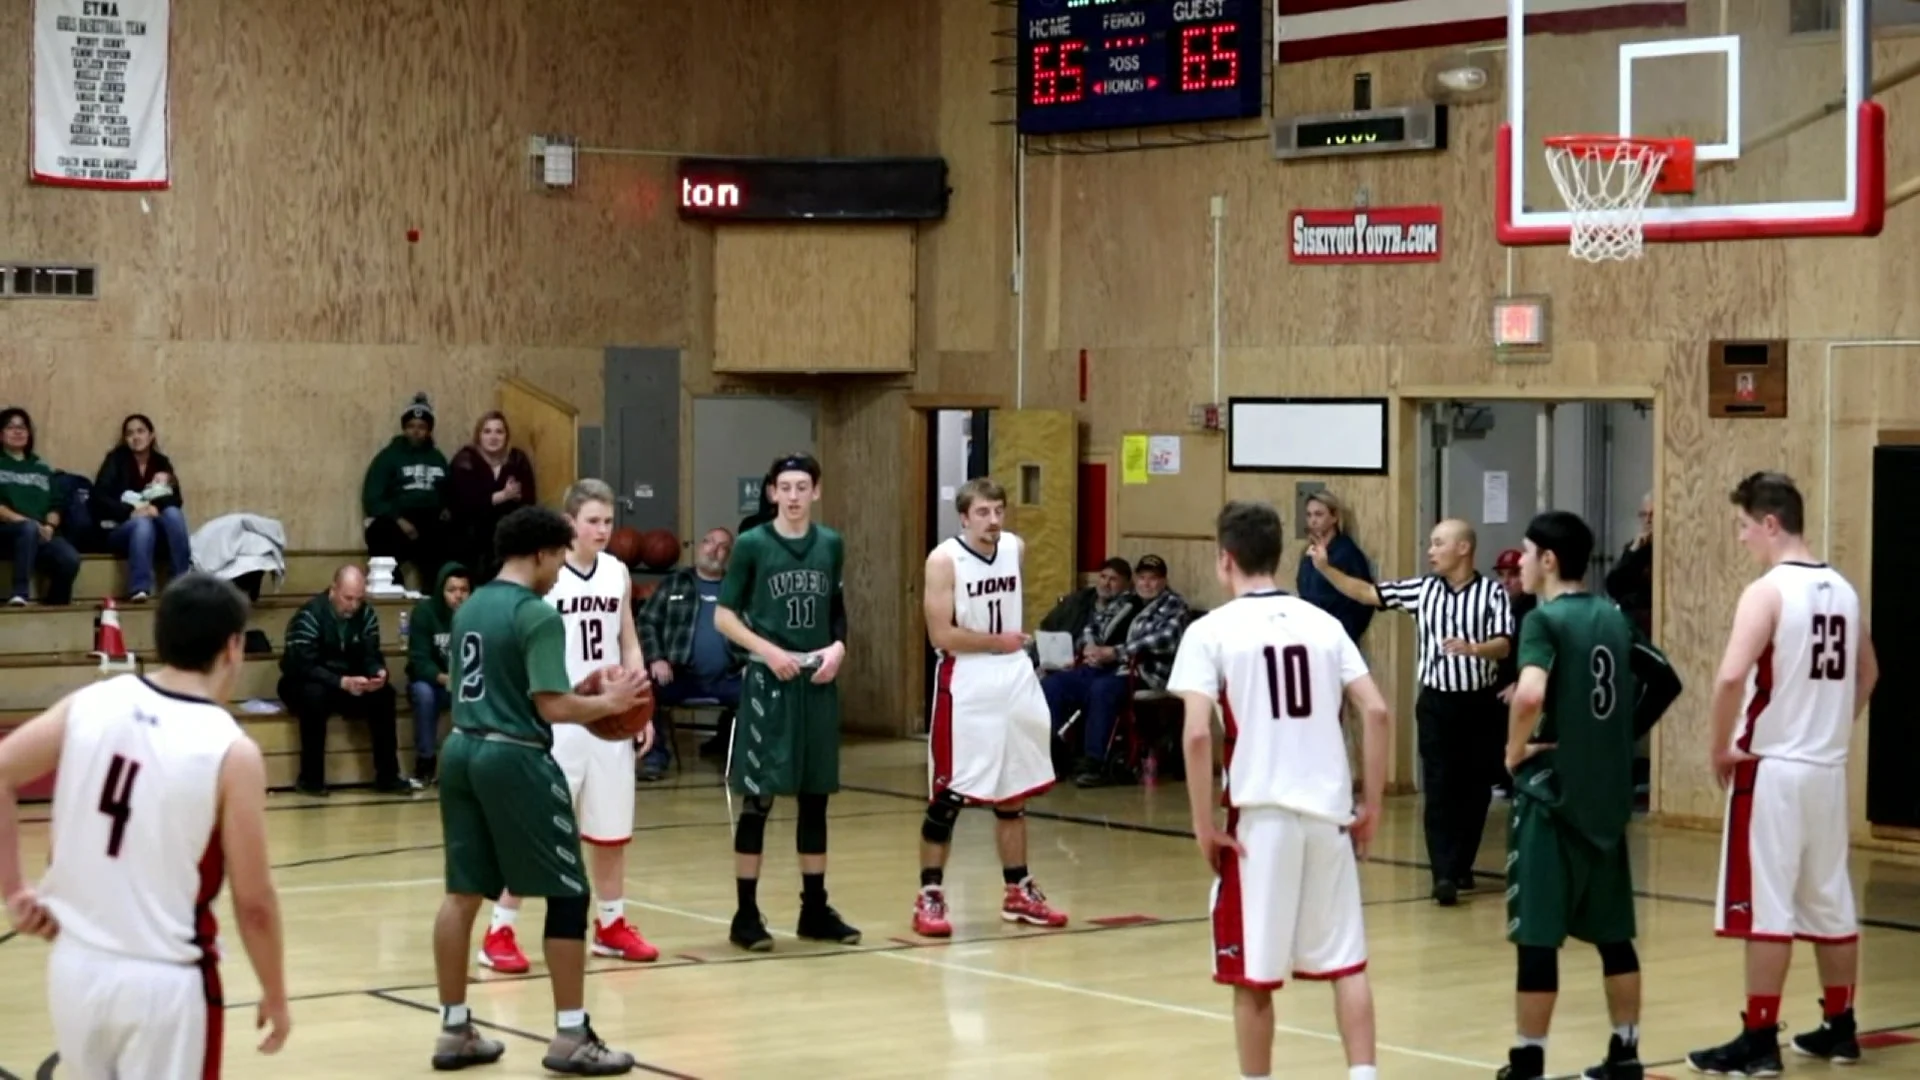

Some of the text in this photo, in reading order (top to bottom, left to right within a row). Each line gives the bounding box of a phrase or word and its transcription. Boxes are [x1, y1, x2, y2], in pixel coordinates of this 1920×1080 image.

[83, 1, 119, 16] ETNA
[1103, 11, 1145, 30] PERIOD
[1173, 0, 1225, 22] GUEST
[126, 20, 147, 35] TEAM
[1029, 15, 1071, 39] HOME
[1033, 43, 1082, 104] 65
[1182, 24, 1237, 91] 65
[683, 177, 739, 206] ton
[768, 569, 829, 598] WEED
[966, 575, 1017, 597] LIONS
[557, 596, 620, 615] LIONS
[787, 596, 816, 628] 11
[987, 599, 1002, 634] 11
[580, 619, 603, 661] 12
[1809, 614, 1847, 681] 23
[458, 631, 486, 703] 2
[1263, 644, 1313, 720] 10
[1590, 645, 1616, 721] 3
[98, 753, 141, 858] 4
